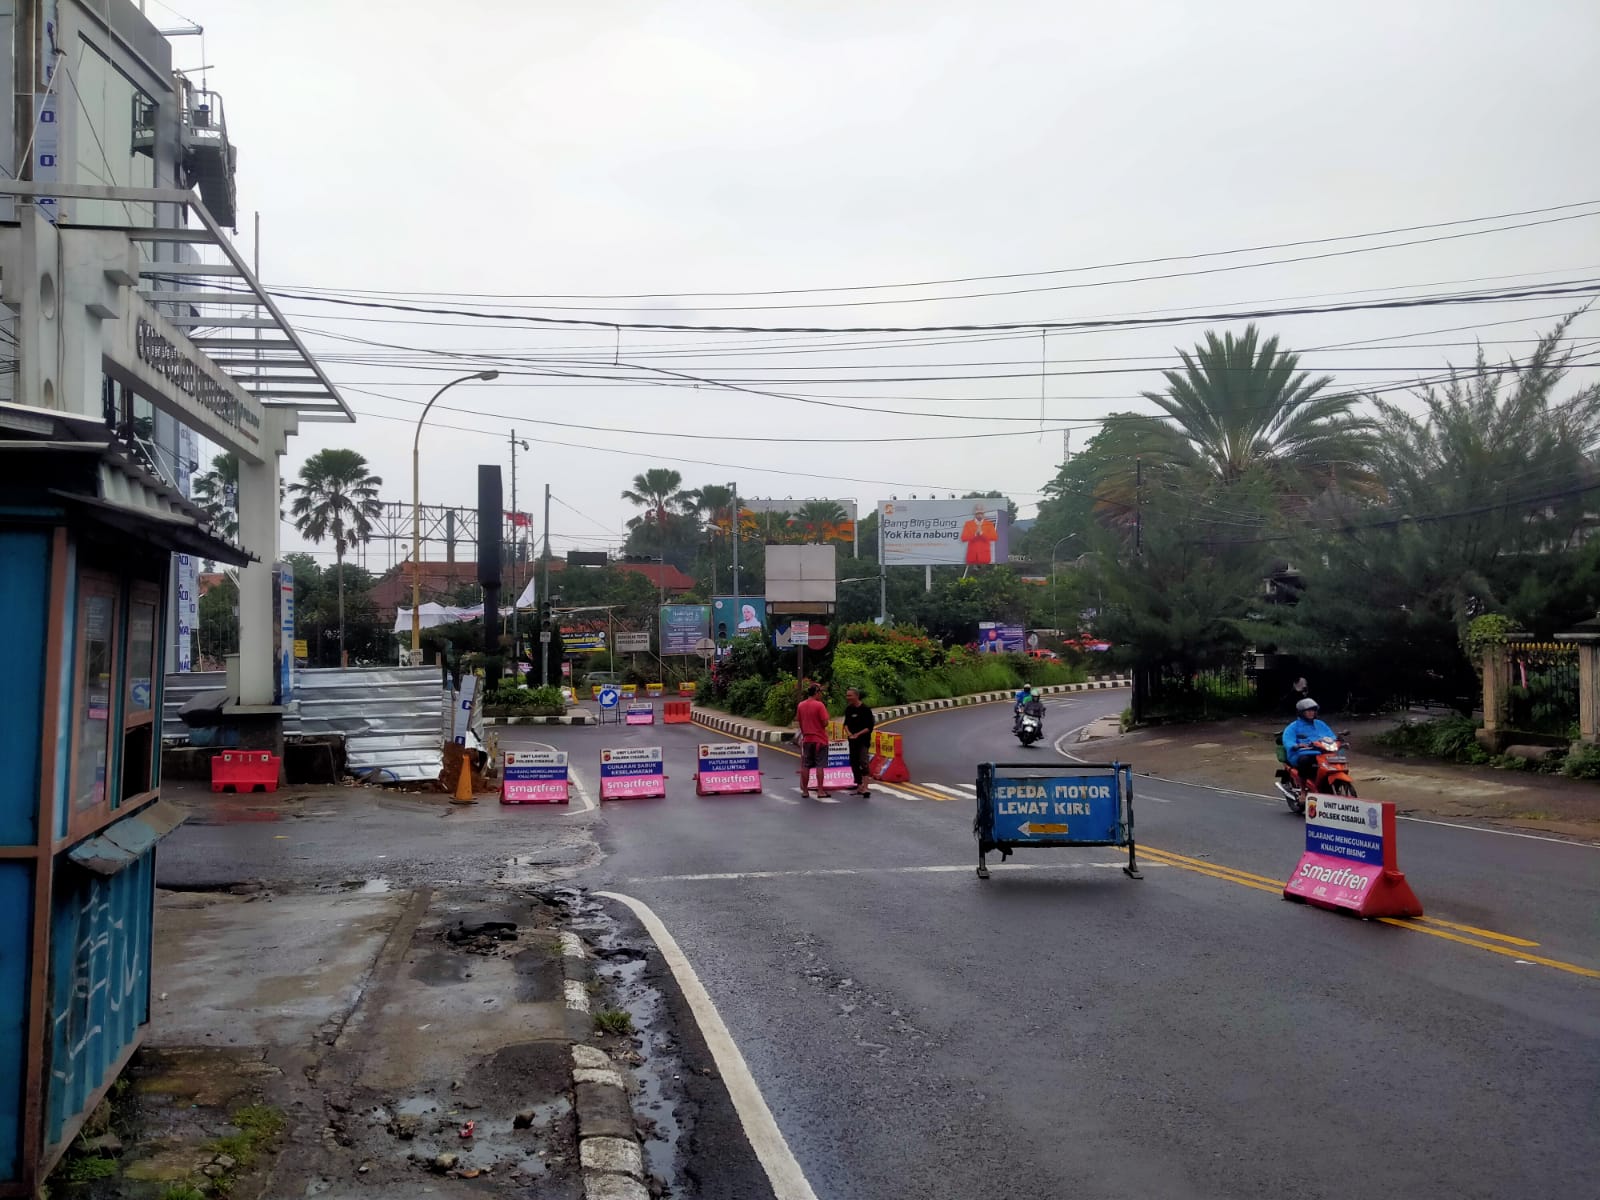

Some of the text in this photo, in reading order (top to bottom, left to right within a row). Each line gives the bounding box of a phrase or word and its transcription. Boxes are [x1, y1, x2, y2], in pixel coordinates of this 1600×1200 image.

[883, 519, 957, 529] Bang Bing Bung
[884, 530, 959, 540] Yok kita nabung
[607, 778, 659, 789] smartfren
[705, 773, 756, 784] smartfren
[509, 783, 563, 793] smartfren
[1055, 785, 1111, 799] MOTOR
[998, 801, 1091, 816] LEWAT KIRI
[1323, 801, 1360, 814] UNIT LANTAS
[1318, 811, 1366, 825] POLSEK CISARUA
[1307, 830, 1380, 850] DILARANG MENGGUNAKAN
[1320, 843, 1366, 858] KNALPOT BISING
[1300, 863, 1369, 891] smartfren
